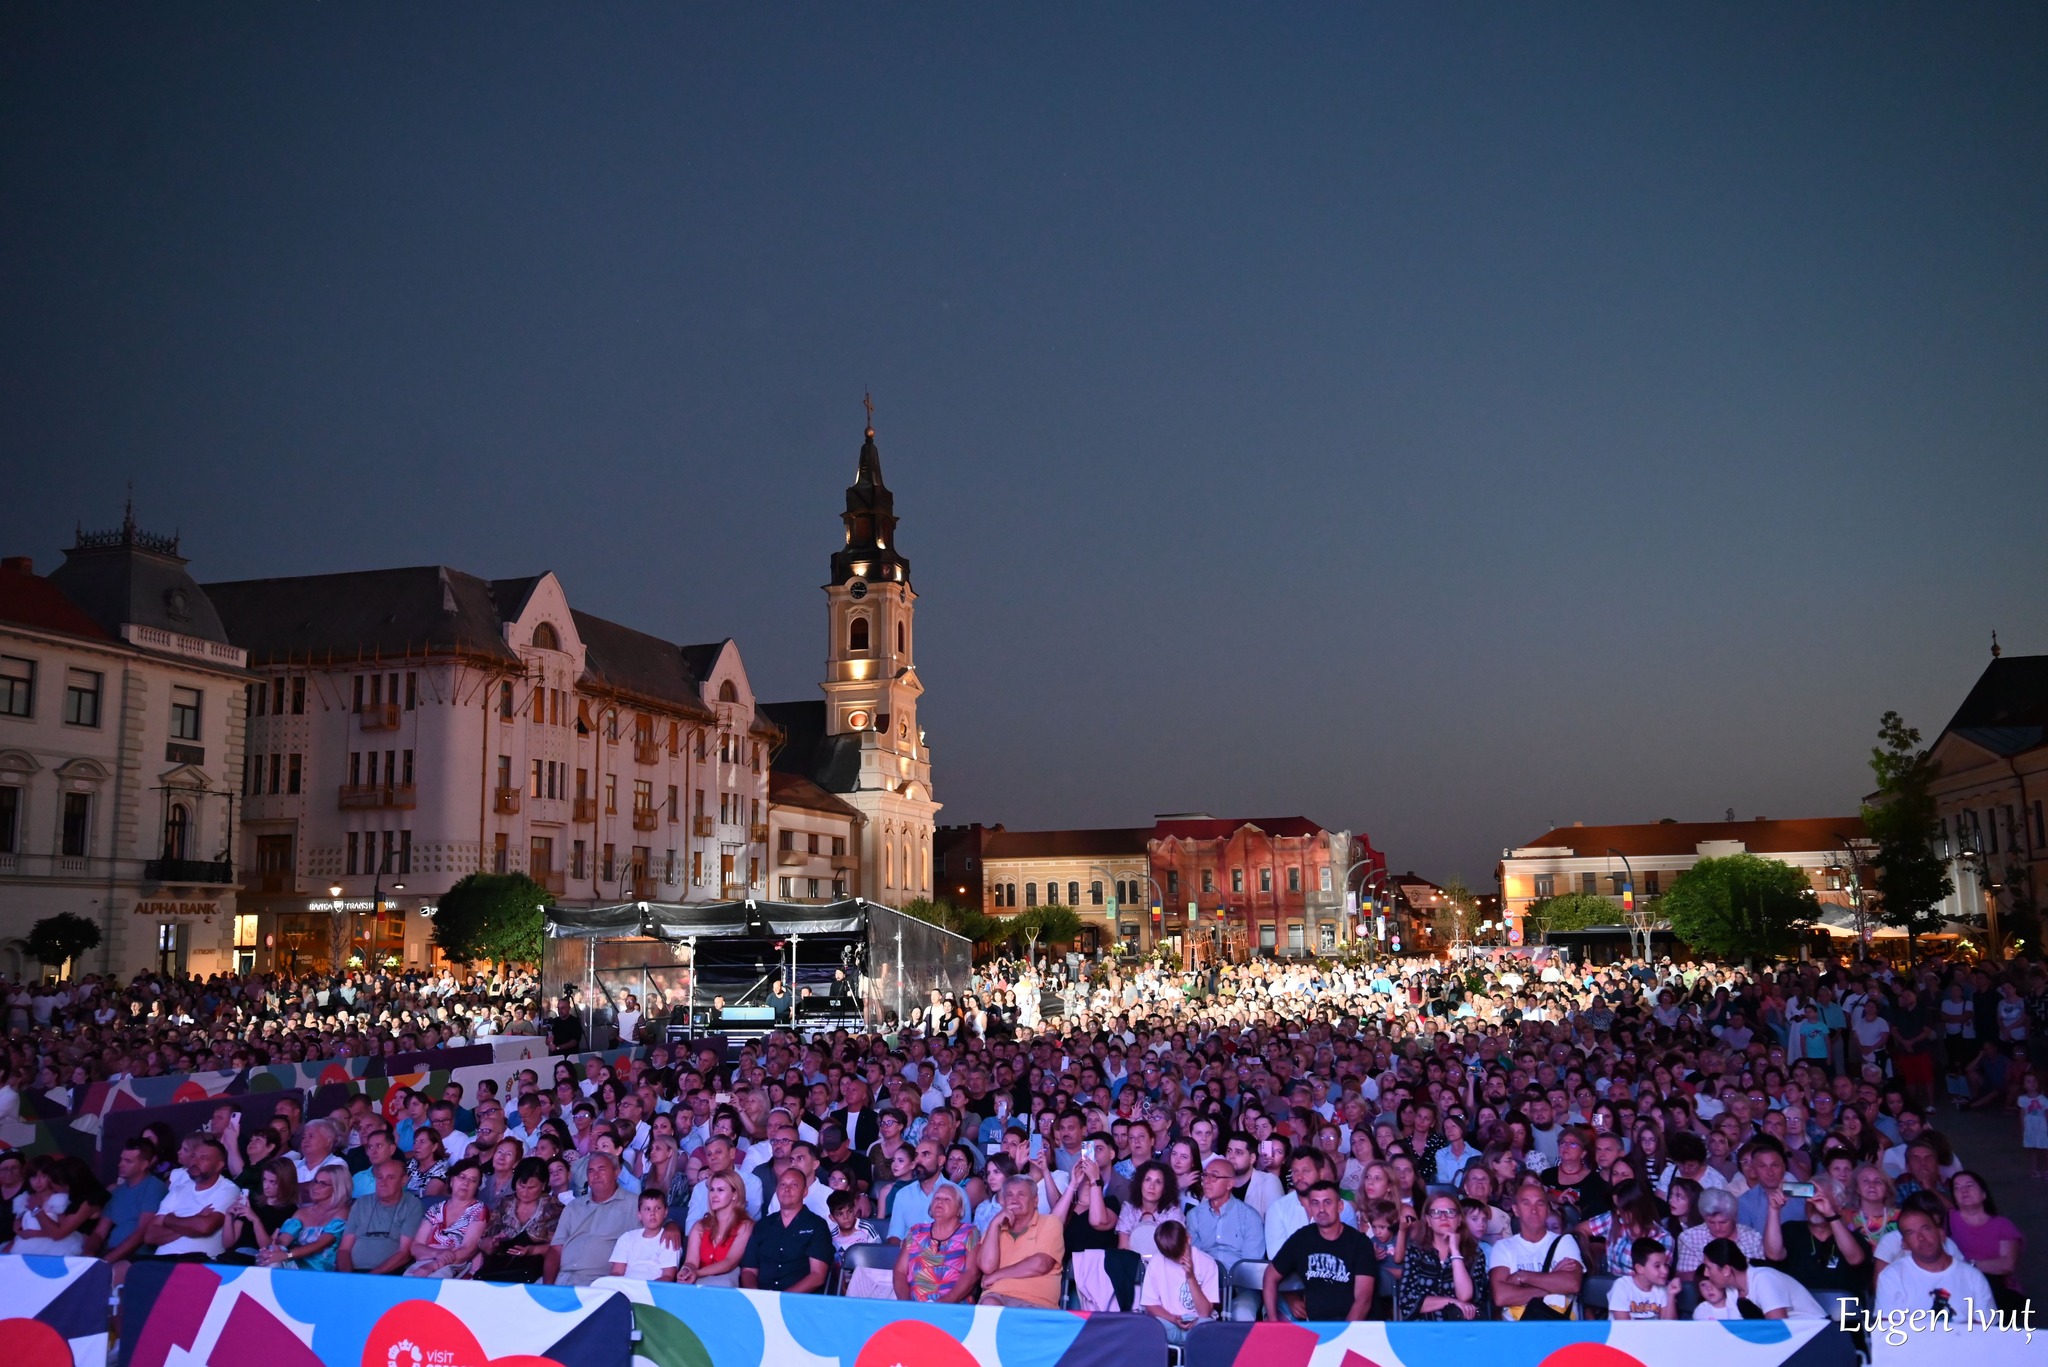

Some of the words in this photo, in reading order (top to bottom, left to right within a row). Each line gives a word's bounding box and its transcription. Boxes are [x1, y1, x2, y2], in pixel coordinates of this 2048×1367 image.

[134, 902, 178, 915] ALPHA
[179, 902, 217, 915] BANK
[309, 902, 333, 911] BANCA
[1308, 1252, 1346, 1277] PUMA
